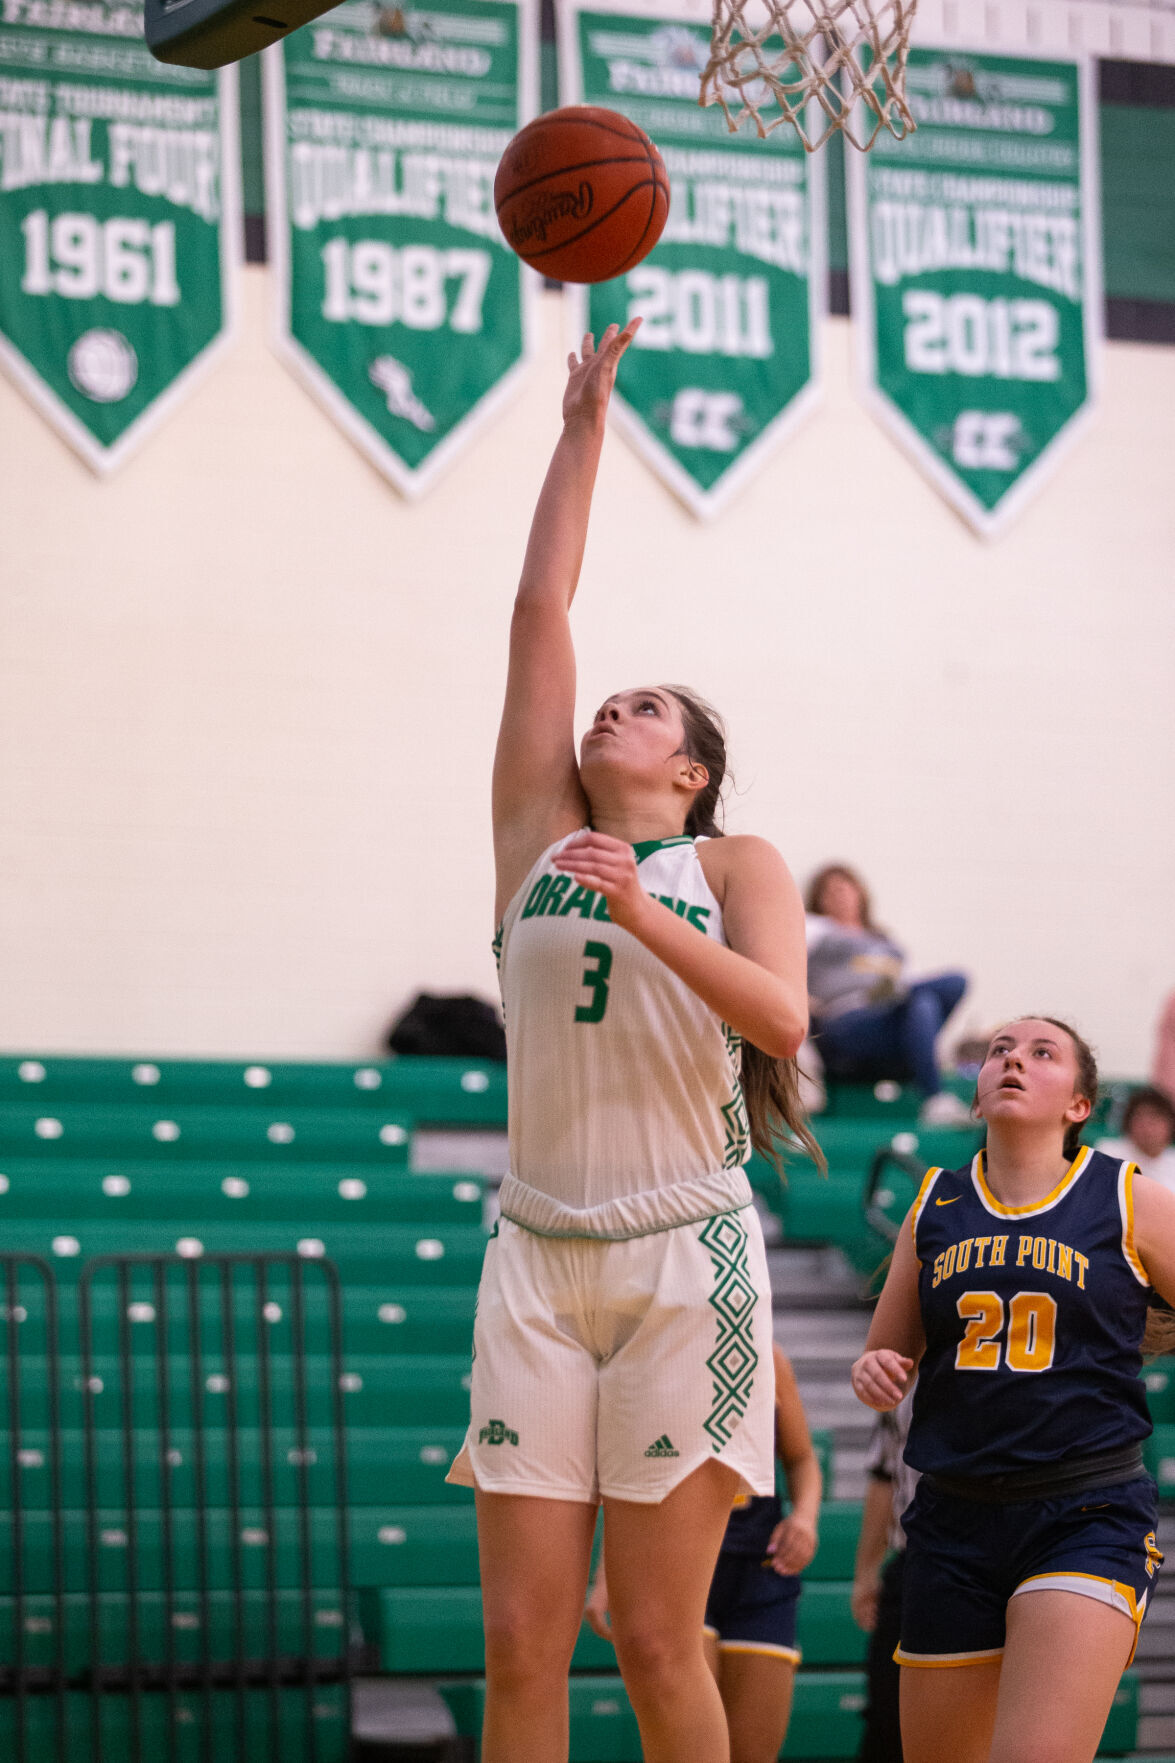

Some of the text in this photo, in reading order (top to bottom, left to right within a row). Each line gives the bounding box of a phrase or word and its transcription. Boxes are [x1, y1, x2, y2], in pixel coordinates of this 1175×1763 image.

[292, 142, 510, 250] QUALIFIE
[21, 208, 181, 306] 1961
[321, 237, 492, 334] 1987
[873, 200, 1083, 304] QUALIFIER
[626, 264, 774, 359] 2011
[902, 289, 1061, 382] 2012
[574, 940, 613, 1024] 3
[931, 1235, 1090, 1291] SOUTH POINT
[954, 1290, 1058, 1373] 20
[644, 1448, 680, 1457] adidas
